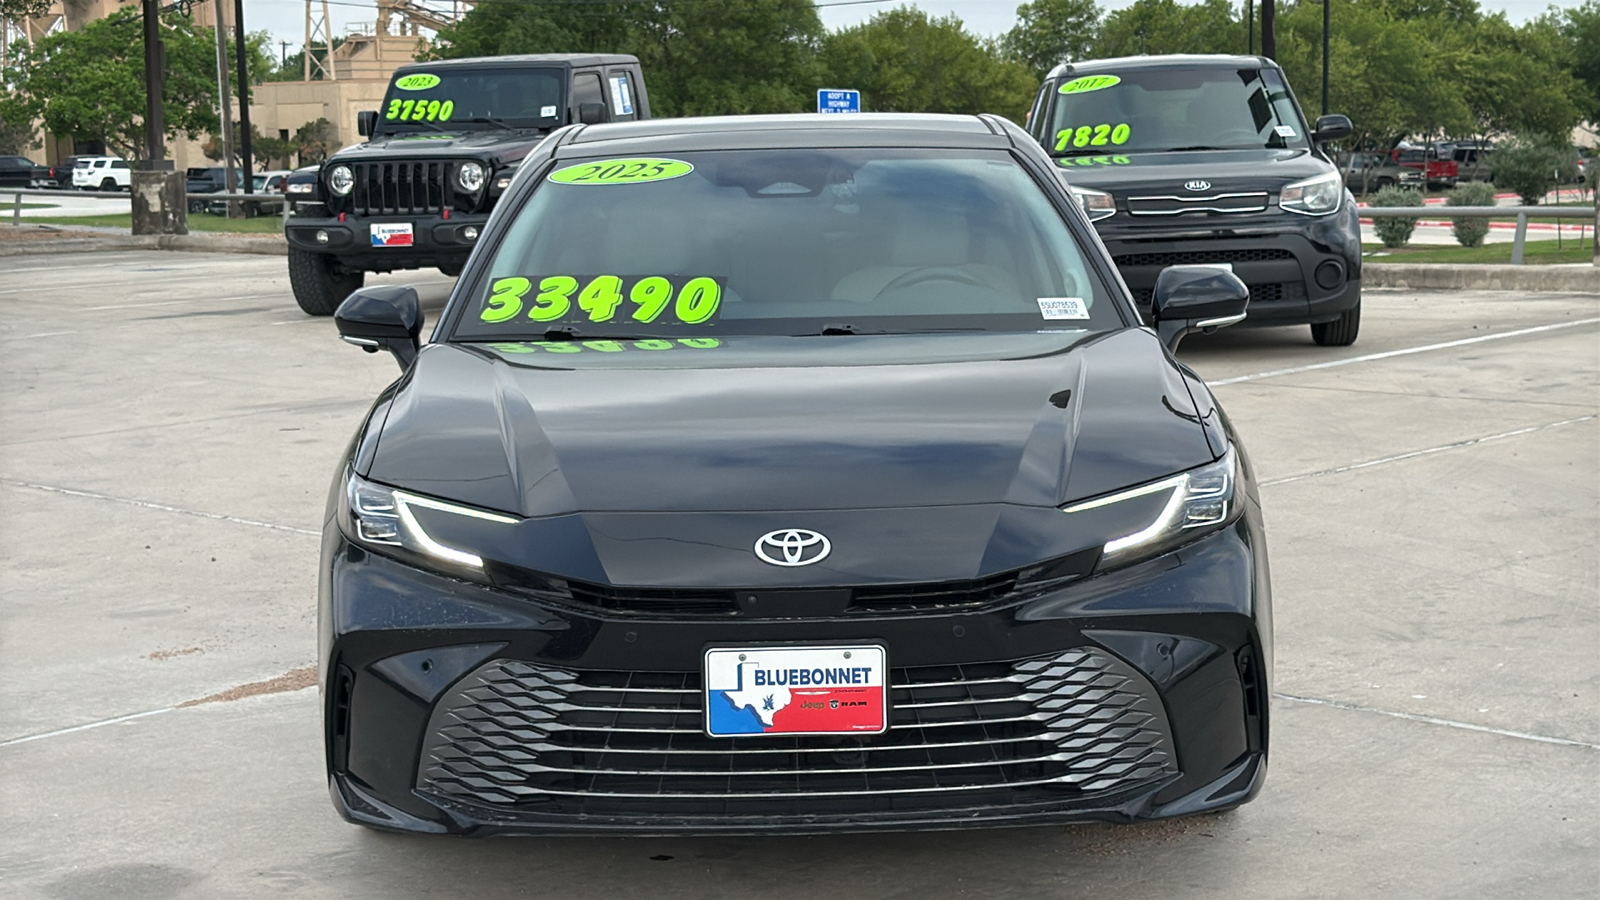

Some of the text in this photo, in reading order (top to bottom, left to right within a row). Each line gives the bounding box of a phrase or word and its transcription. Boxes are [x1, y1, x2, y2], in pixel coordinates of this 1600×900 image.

[403, 76, 433, 87] 2023
[1068, 77, 1109, 92] 2017
[385, 98, 454, 121] 37590
[1054, 123, 1131, 151] 7820
[571, 162, 673, 181] 2025
[1188, 180, 1207, 189] KIA
[480, 275, 721, 324] 33490
[755, 667, 872, 686] BLUEBONNET
[801, 701, 825, 709] Jeep
